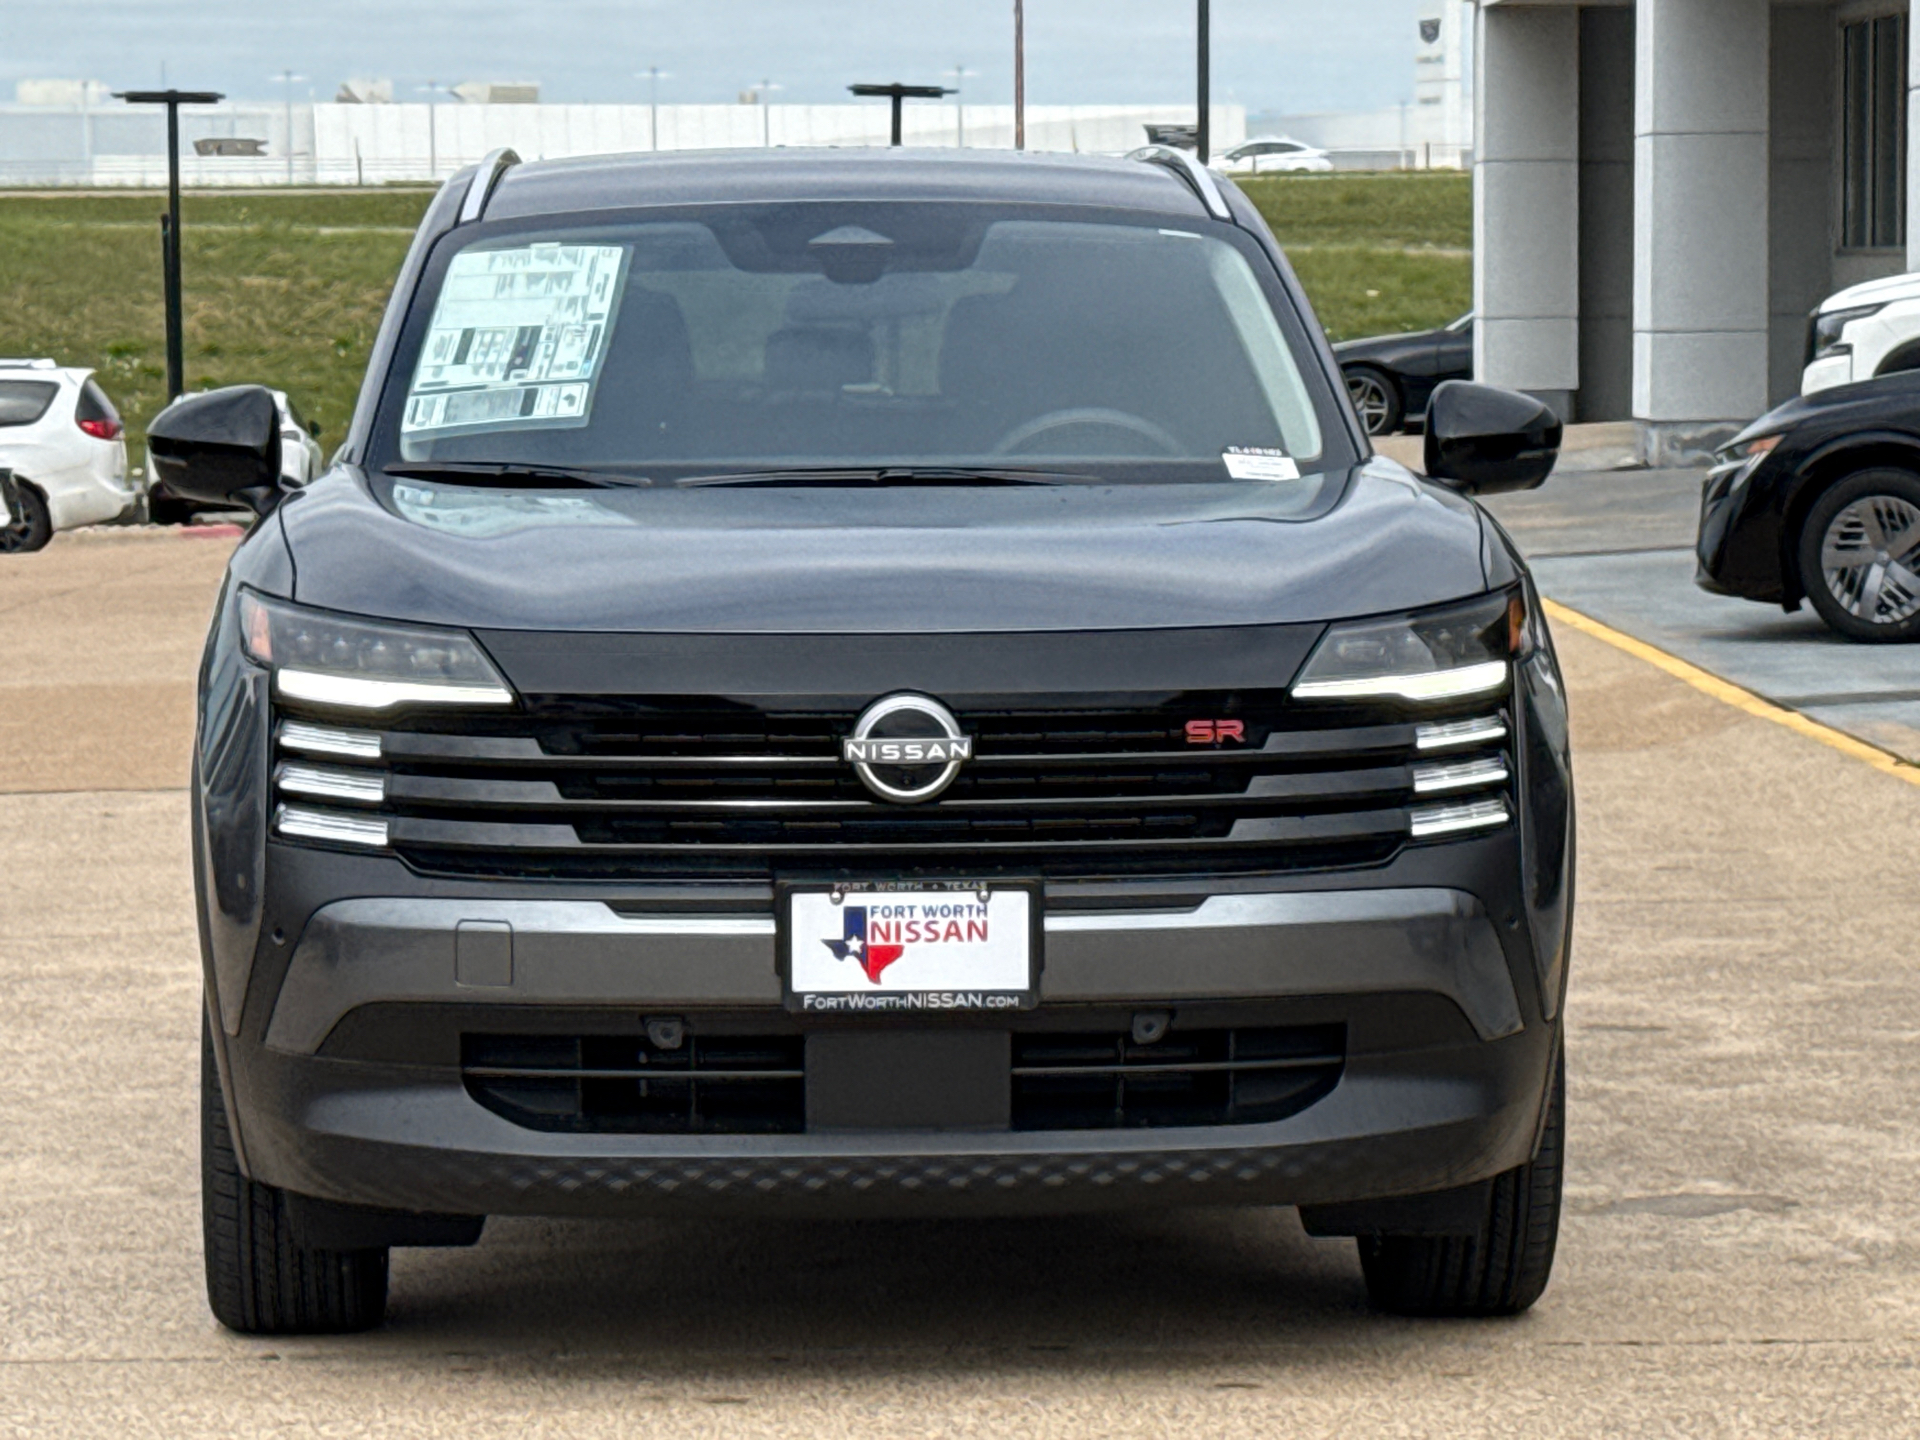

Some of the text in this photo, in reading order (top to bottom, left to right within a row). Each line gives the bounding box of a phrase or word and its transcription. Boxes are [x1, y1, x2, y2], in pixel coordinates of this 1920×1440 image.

[1185, 718, 1246, 743] SR
[846, 740, 970, 760] NISSAN
[834, 881, 988, 893] FORT WORTH TEXAS
[870, 904, 988, 918] FORT WORTH
[870, 919, 988, 943] NISSAN
